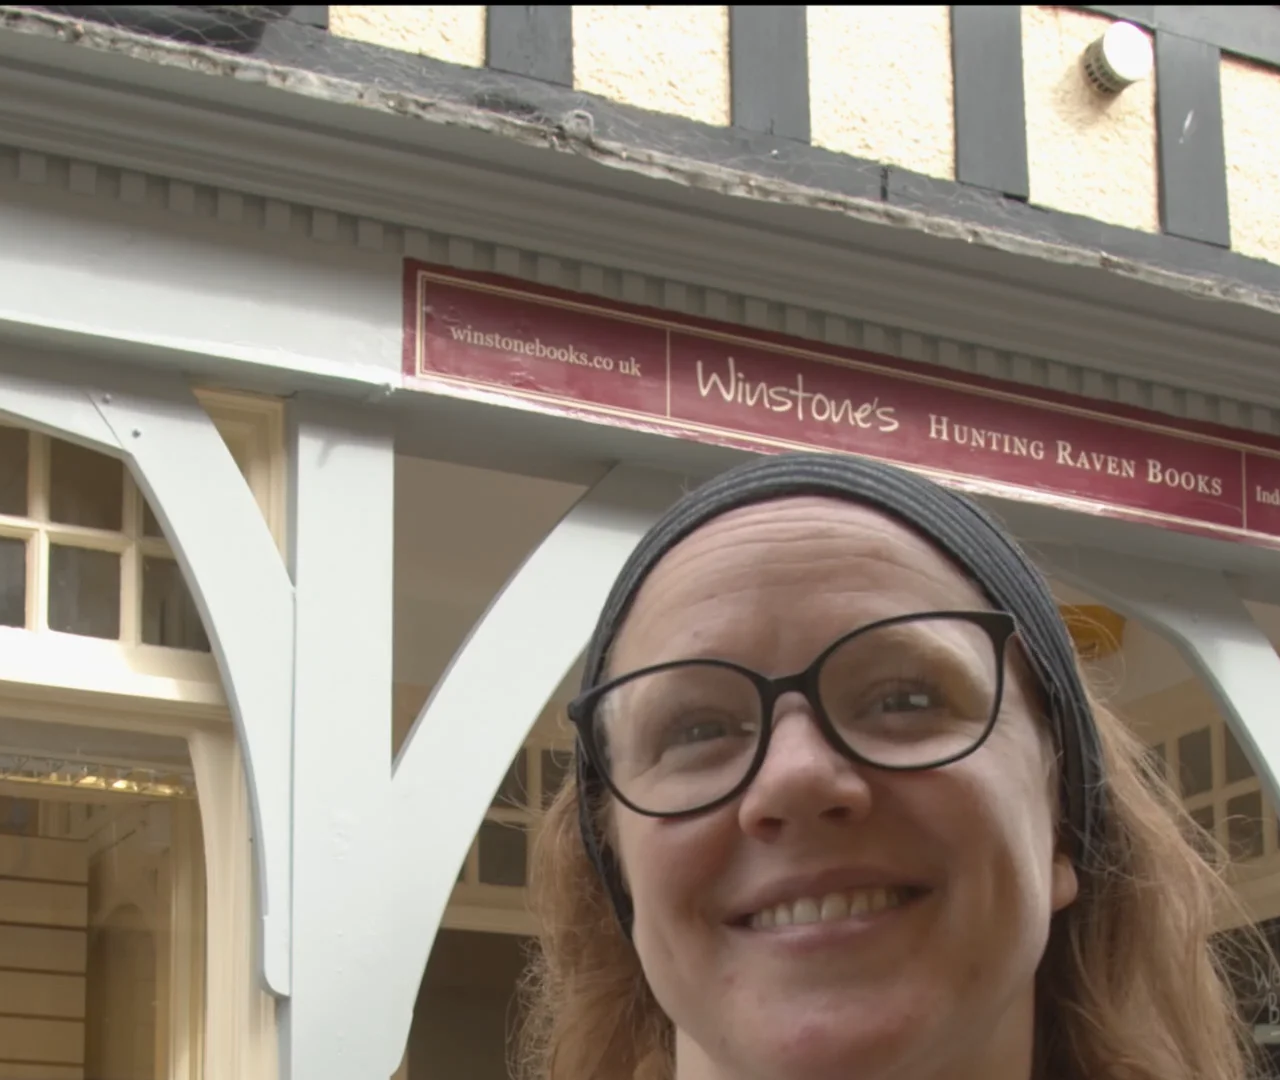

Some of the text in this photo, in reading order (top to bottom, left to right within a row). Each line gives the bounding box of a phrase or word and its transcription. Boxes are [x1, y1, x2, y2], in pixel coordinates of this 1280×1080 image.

[697, 357, 1222, 496] Winstone's HUNTING RAVEN BOOKS
